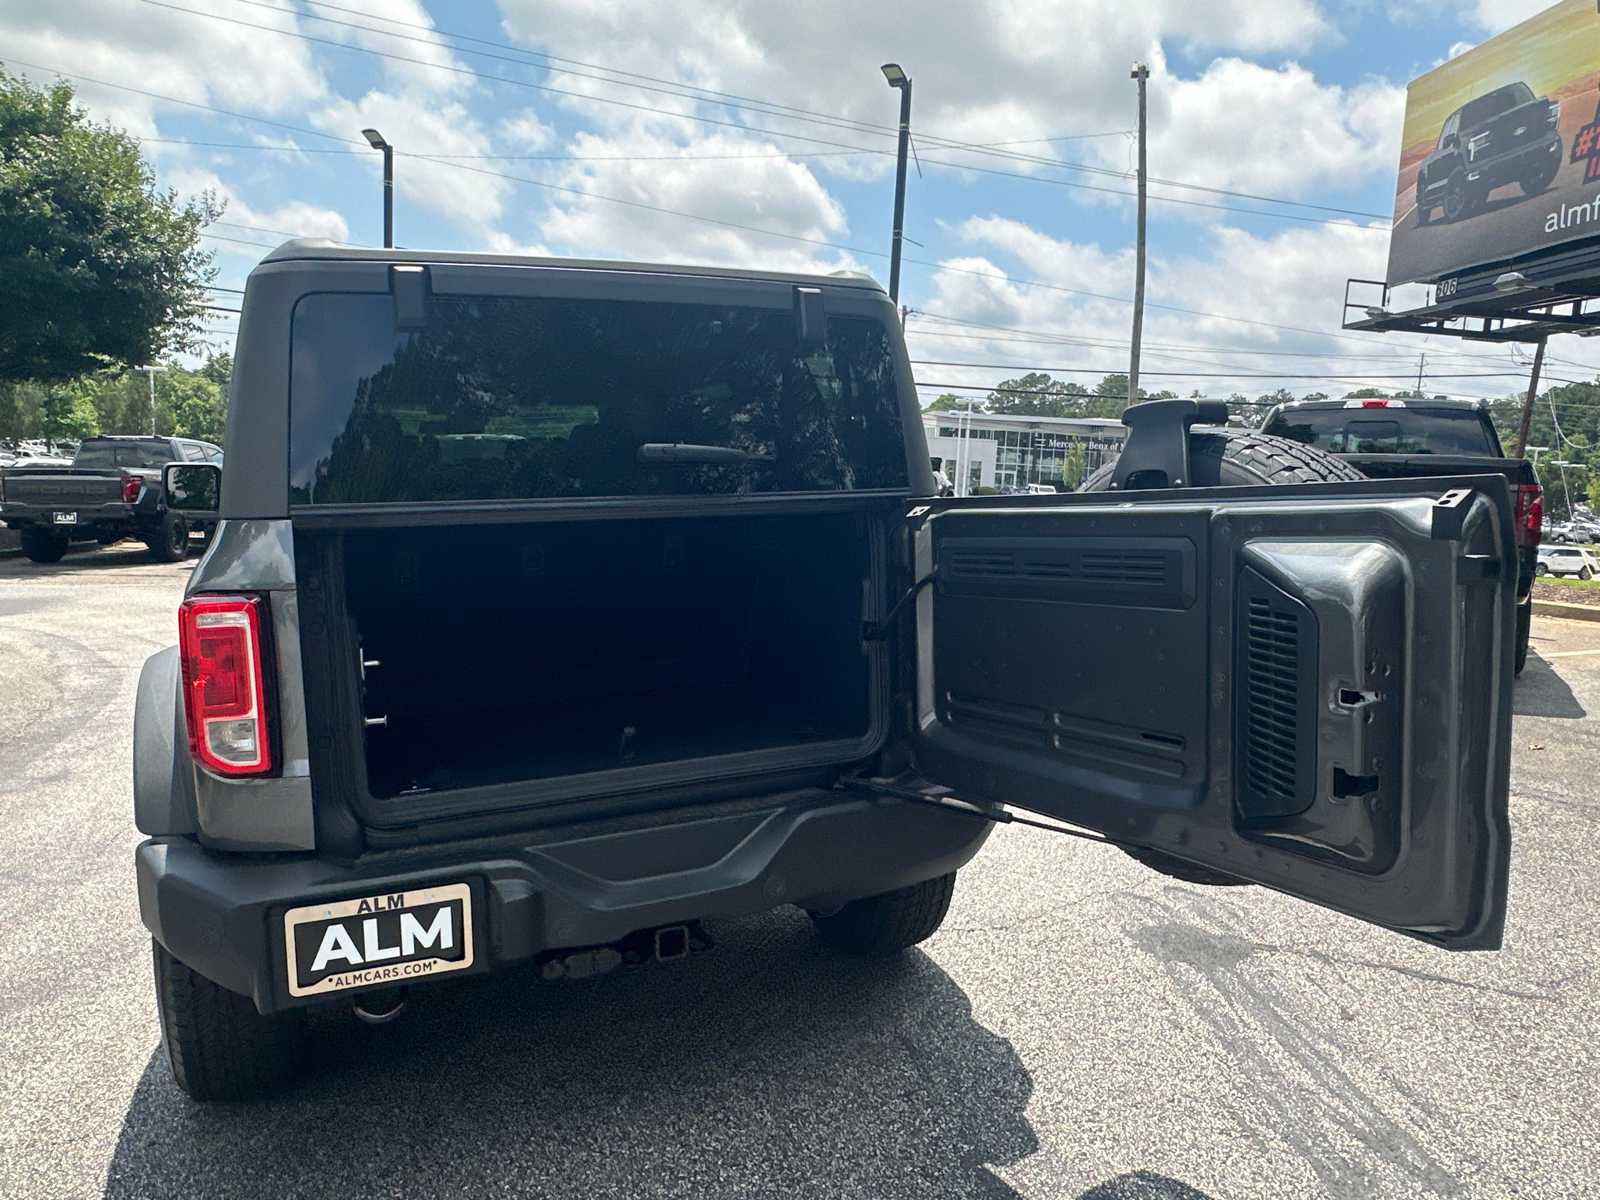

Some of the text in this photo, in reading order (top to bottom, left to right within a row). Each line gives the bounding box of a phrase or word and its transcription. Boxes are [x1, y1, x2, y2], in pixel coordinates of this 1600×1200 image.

[1436, 279, 1457, 297] 606
[1048, 438, 1109, 450] Merce-Benz
[1109, 442, 1119, 451] of
[357, 893, 405, 914] ALM
[310, 906, 453, 972] ALM
[335, 961, 433, 987] ALMCARS.COM
